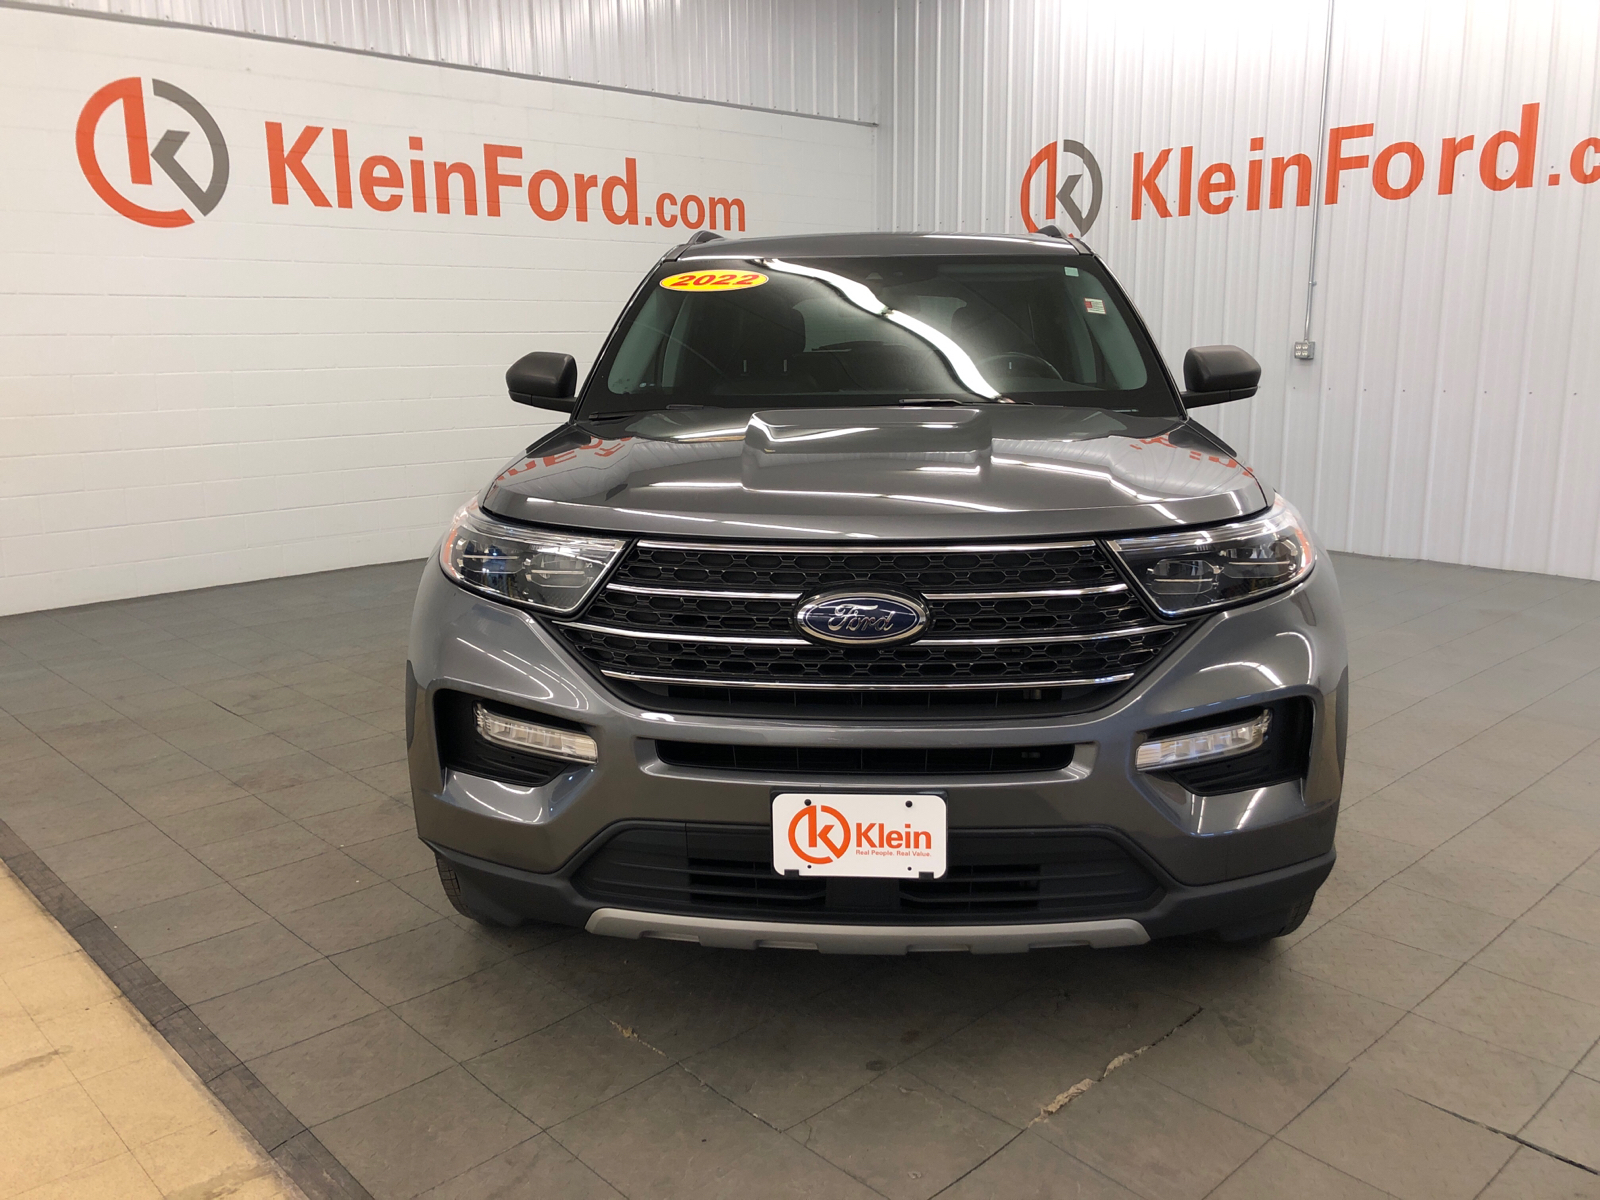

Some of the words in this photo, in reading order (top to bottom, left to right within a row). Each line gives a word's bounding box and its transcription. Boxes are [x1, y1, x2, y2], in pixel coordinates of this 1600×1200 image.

[265, 121, 746, 232] KleinFord.com
[670, 273, 760, 287] 2022
[827, 603, 896, 632] Ford
[855, 822, 932, 849] Klein
[871, 849, 894, 857] People.
